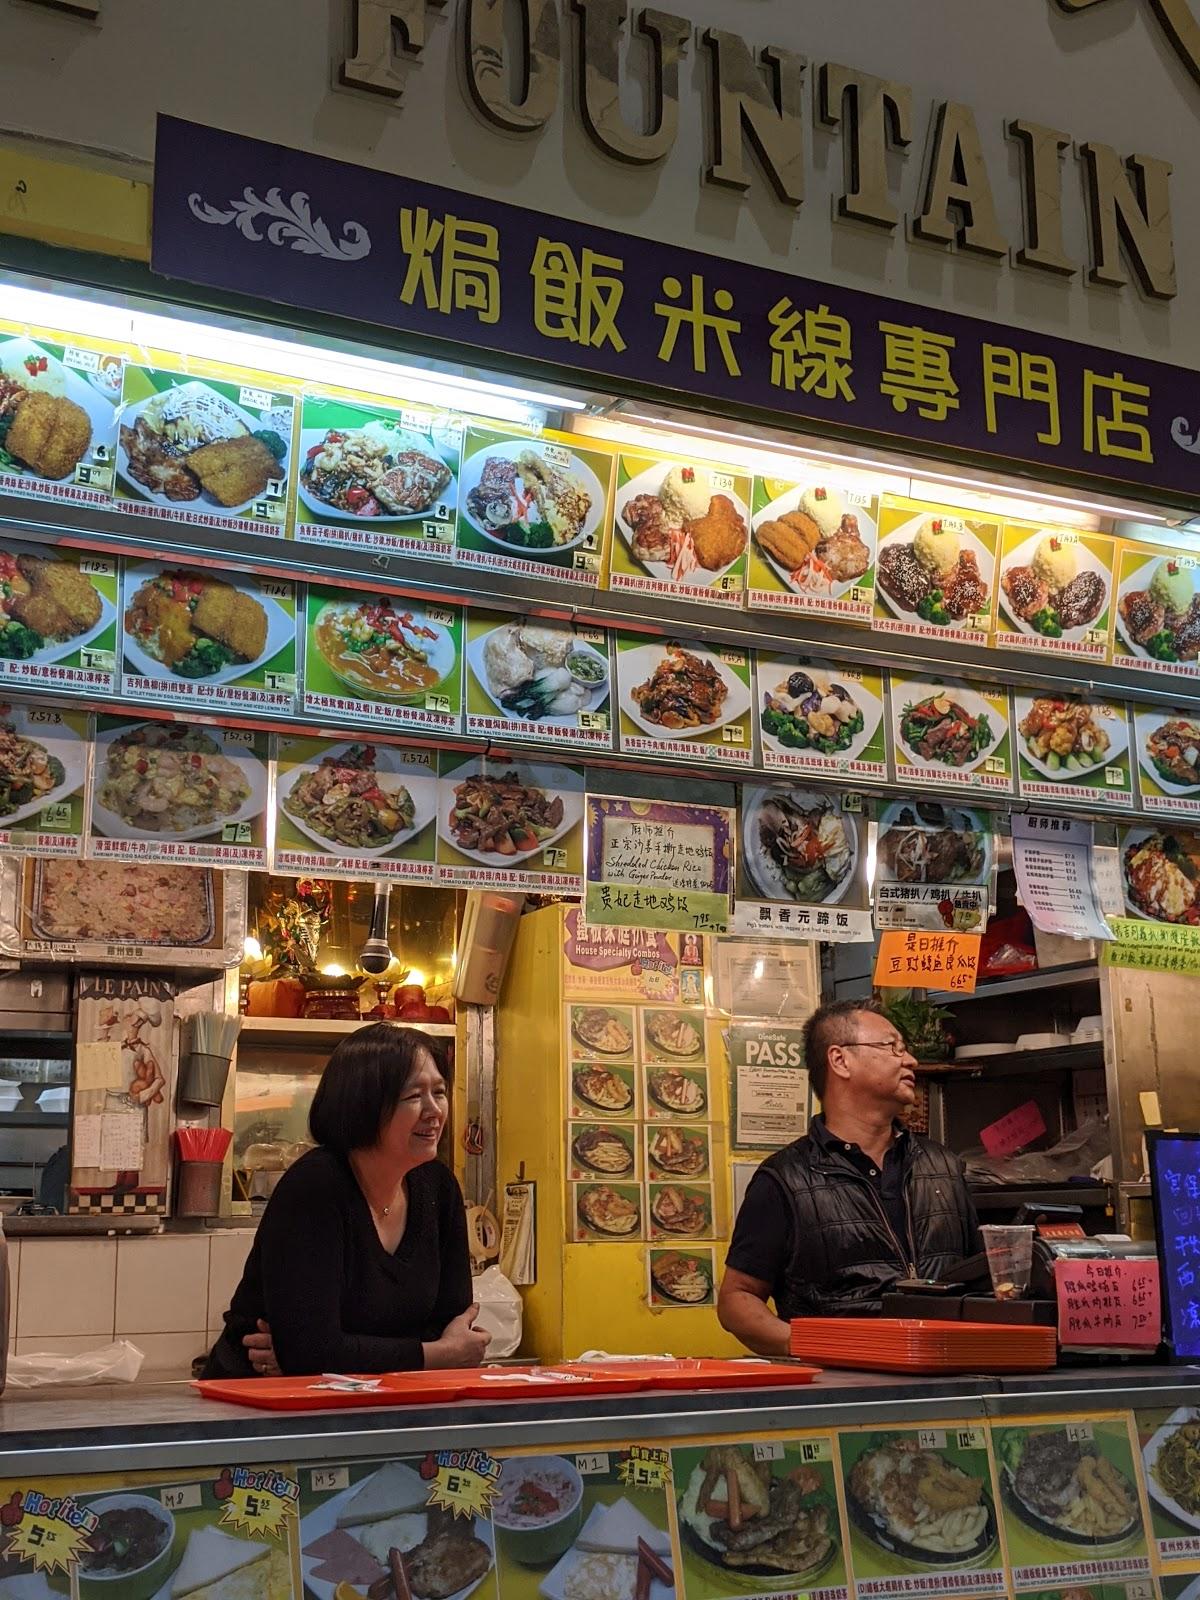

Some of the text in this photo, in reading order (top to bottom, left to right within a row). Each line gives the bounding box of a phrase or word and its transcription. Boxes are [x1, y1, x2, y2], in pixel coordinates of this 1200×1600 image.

[398, 207, 1154, 465] 焗飯米線專門店
[96, 445, 106, 457] 6
[270, 482, 279, 494] 7
[438, 504, 447, 517] 8
[586, 534, 594, 547] 9
[649, 858, 680, 872] Chicken
[682, 860, 702, 872] Rice
[607, 868, 625, 878] with
[575, 945, 660, 959] House Specialty Combos
[95, 976, 160, 996] LE PAIN
[758, 1032, 787, 1042] DineSafe
[745, 1041, 801, 1067] PASS
[436, 1449, 503, 1478] Hot item
[233, 1466, 300, 1500] Hot item
[24, 1489, 100, 1534] Hot item
